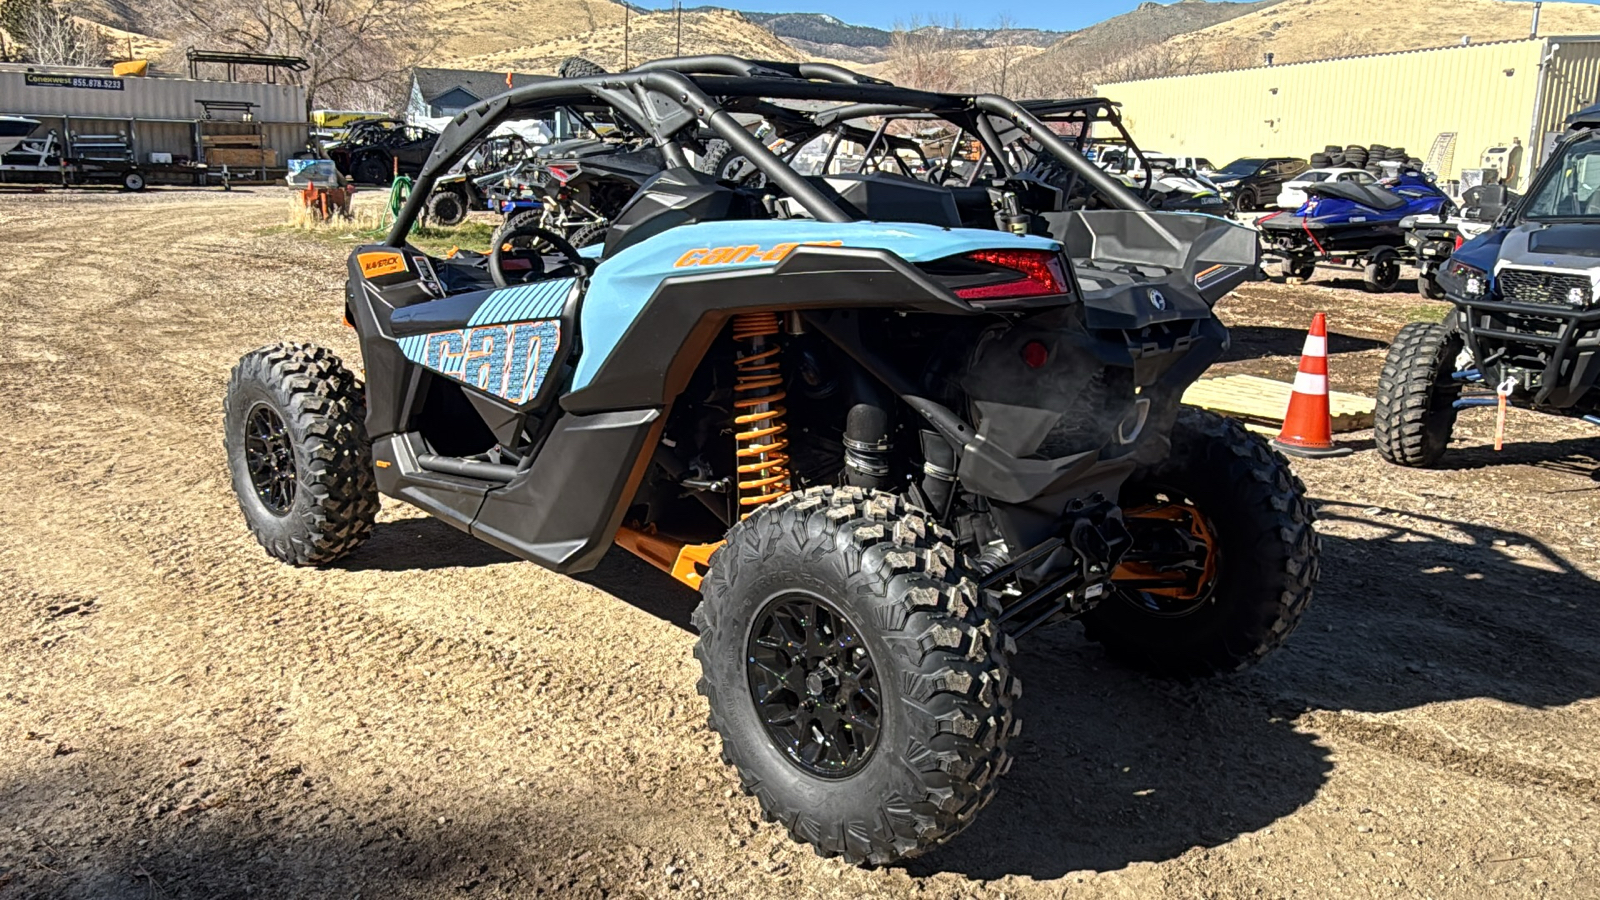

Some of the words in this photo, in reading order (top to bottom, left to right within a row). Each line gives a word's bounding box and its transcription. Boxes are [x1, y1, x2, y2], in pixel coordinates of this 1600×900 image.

[27, 74, 71, 84] Conexwest
[72, 78, 121, 89] 855.878.5233
[673, 240, 843, 268] can-a
[365, 256, 399, 271] MAVERICK
